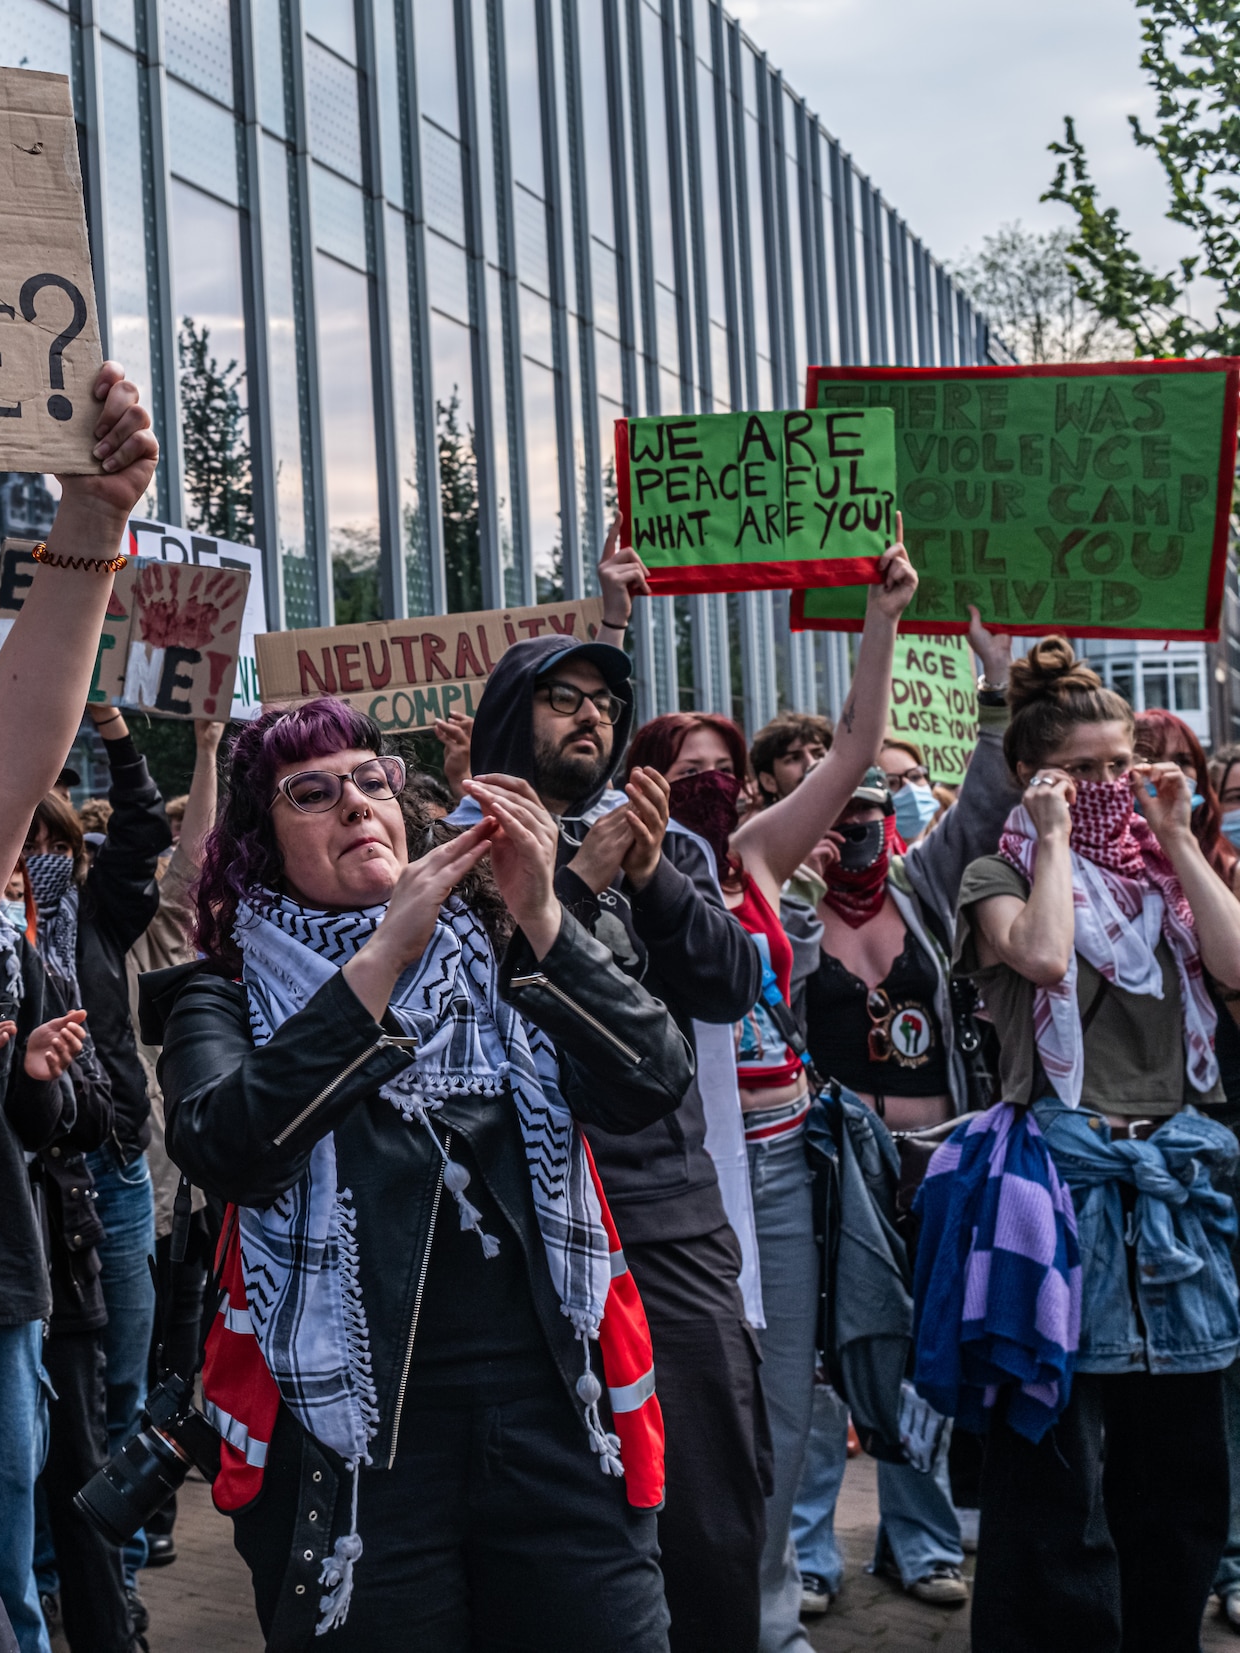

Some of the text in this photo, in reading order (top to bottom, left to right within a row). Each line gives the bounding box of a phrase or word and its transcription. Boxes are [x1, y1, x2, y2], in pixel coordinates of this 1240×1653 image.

[1055, 379, 1166, 434] WAS
[629, 411, 865, 465] WE ARE
[903, 432, 1173, 484] VIOLENCE
[633, 490, 895, 550] WHAT ARE YOU?
[902, 473, 1209, 533] OUR CAMP
[1034, 527, 1185, 580] YOU
[911, 578, 1142, 622] RRIVED
[906, 648, 957, 680] AGE
[890, 708, 942, 734] LOSE
[891, 678, 976, 716] DID YOU
